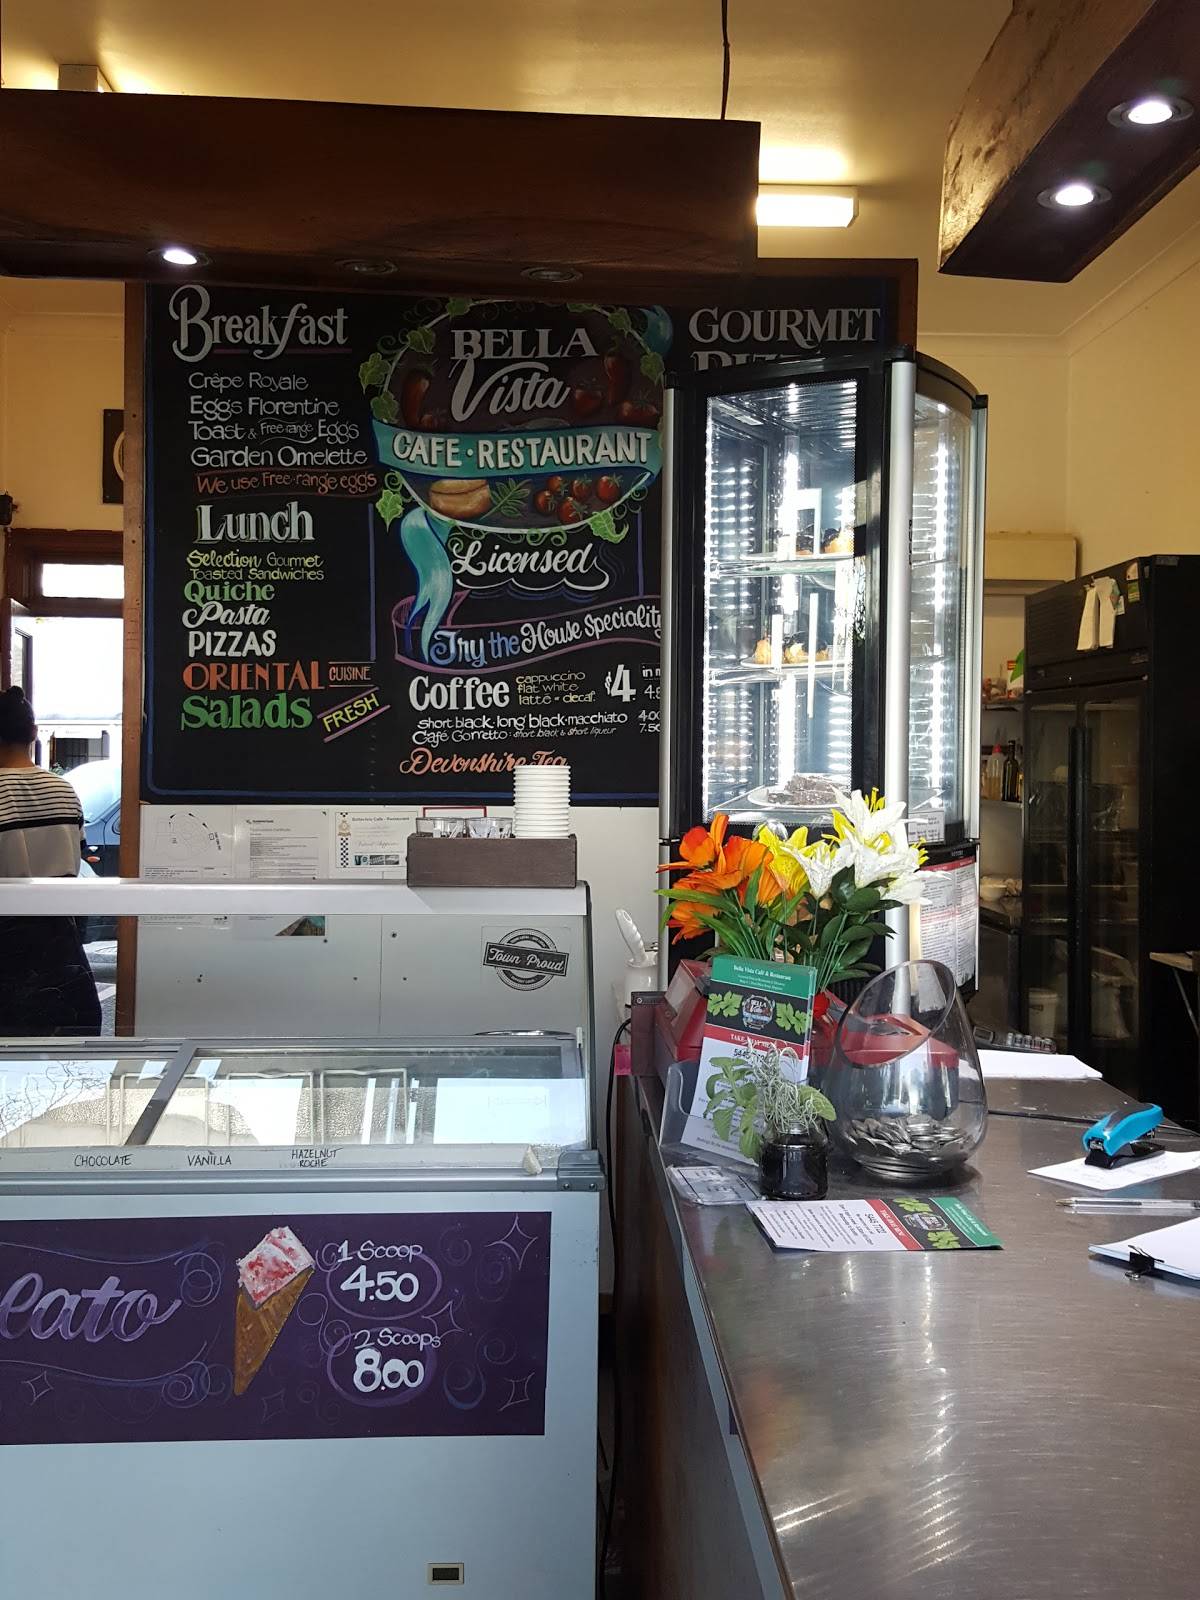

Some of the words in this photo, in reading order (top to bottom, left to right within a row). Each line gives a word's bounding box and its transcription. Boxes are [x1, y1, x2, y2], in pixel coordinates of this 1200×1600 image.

[169, 284, 348, 362] Breakfast
[689, 307, 881, 349] GOURMET
[450, 328, 600, 360] BELLA
[249, 372, 309, 392] Royale
[449, 353, 571, 422] Vista
[190, 395, 242, 422] Eggs
[248, 397, 340, 416] Florentine
[188, 421, 247, 441] Toast
[248, 428, 257, 440] &
[318, 419, 360, 444] Eggs
[190, 446, 273, 468] Garden
[277, 446, 368, 467] Omelette
[393, 432, 462, 467] CAFE
[477, 432, 652, 469] RESTAURANT
[197, 476, 228, 494] We
[231, 474, 260, 489] use
[340, 472, 377, 494] eggs
[195, 501, 315, 543] Lunch
[186, 549, 262, 568] Selection
[267, 552, 324, 567] Gourmet
[450, 540, 600, 577] Licensed
[190, 568, 243, 581] Toasted
[248, 568, 325, 581] Sandwiches
[184, 579, 275, 609] Quiche
[182, 601, 270, 628] Pasta
[188, 630, 277, 658] PIZZAS
[430, 630, 488, 667] Try
[489, 631, 520, 659] the
[521, 620, 583, 654] House
[182, 660, 325, 691] ORIENTAL
[329, 666, 372, 681] CUISINE
[515, 670, 586, 685] cappuccino
[517, 684, 540, 694] flat
[542, 682, 579, 692] white
[409, 675, 510, 711] Coffee
[181, 693, 313, 730] Salads
[322, 693, 380, 732] FRESH
[417, 717, 452, 729] short
[455, 714, 494, 729] black
[496, 715, 526, 731] long
[529, 713, 566, 729] black
[567, 712, 628, 726] macchiato
[411, 730, 449, 748] Café
[513, 729, 535, 738] short
[536, 728, 560, 738] black
[567, 727, 589, 736] short
[400, 747, 527, 775] Devonshire
[488, 948, 521, 965] Town
[527, 954, 564, 972] Proud
[74, 1154, 133, 1166] CHOCOLATE
[187, 1151, 232, 1167] VANILLA
[291, 1147, 343, 1159] HAZELNUT
[299, 1158, 328, 1167] ROCHE
[338, 1240, 353, 1262] 1
[357, 1240, 423, 1263] Scoop
[340, 1264, 419, 1302] 4.50
[354, 1329, 375, 1349] 2
[377, 1328, 442, 1351] Scoops
[353, 1348, 425, 1393] 8.00
